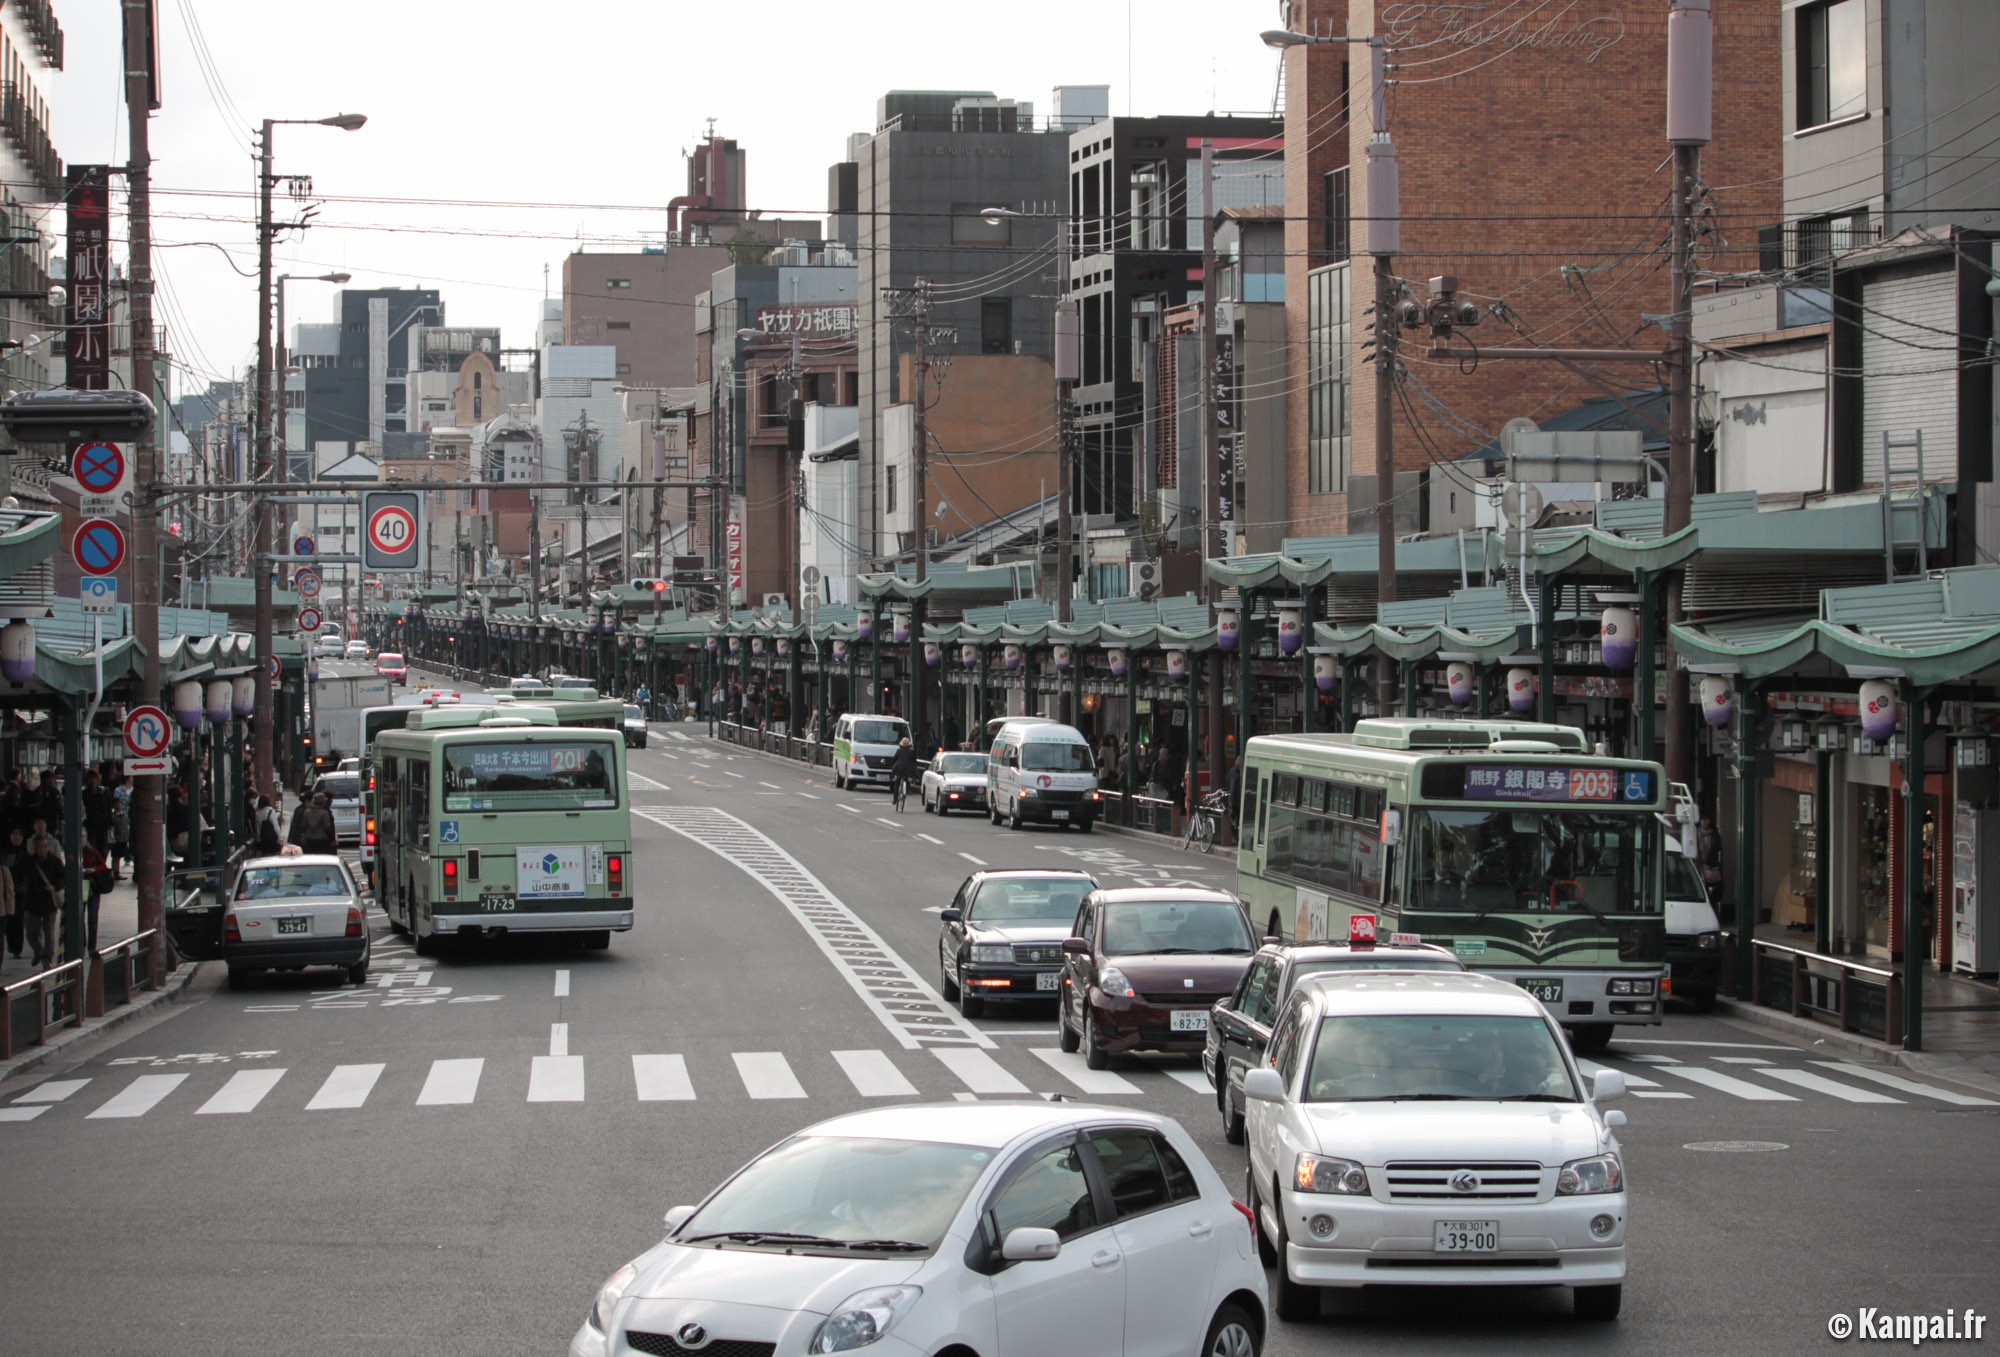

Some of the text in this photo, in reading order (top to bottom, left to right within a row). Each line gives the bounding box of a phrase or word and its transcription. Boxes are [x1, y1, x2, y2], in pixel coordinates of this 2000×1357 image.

[380, 520, 405, 540] 40
[726, 524, 741, 589] カラオケ
[501, 751, 549, 766] 千本今出川
[554, 750, 582, 770] 201
[1504, 769, 1567, 791] 銀閣寺
[1573, 771, 1612, 798] 203
[532, 882, 570, 892] 山中商事
[1448, 1233, 1495, 1249] 39-00
